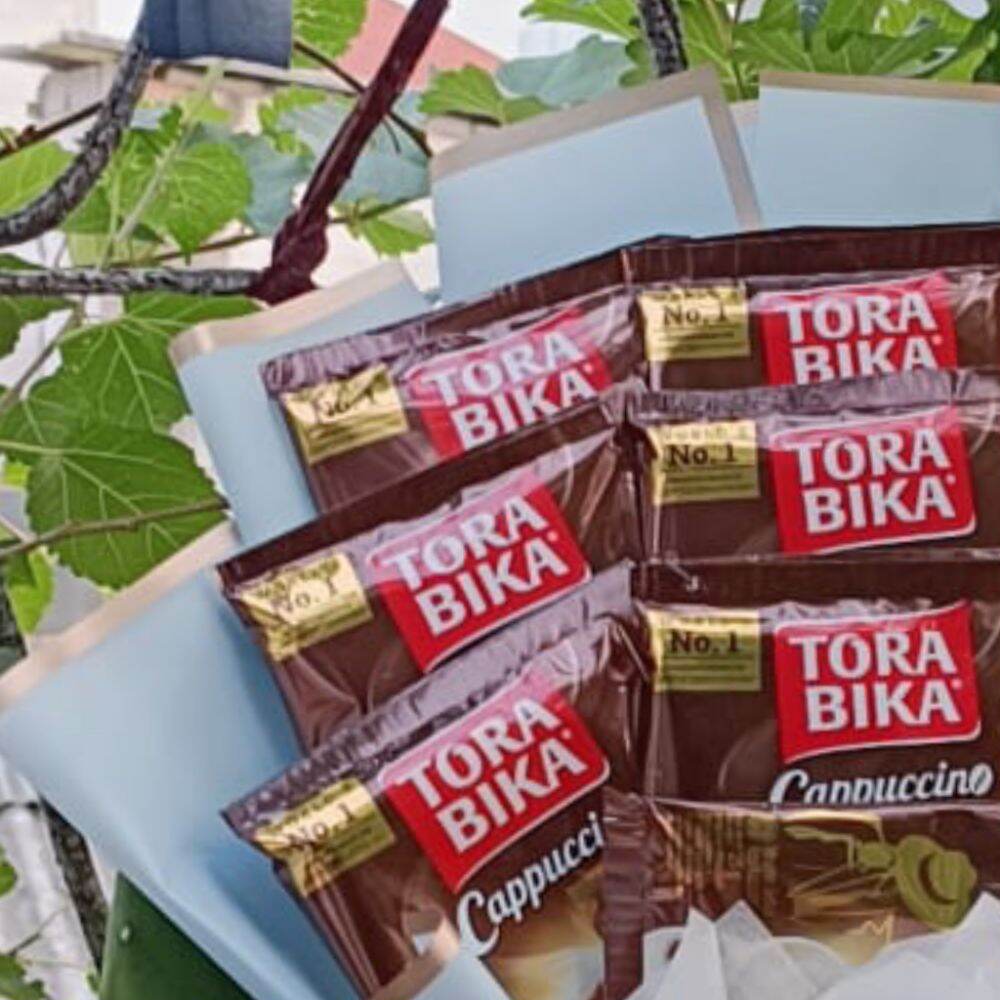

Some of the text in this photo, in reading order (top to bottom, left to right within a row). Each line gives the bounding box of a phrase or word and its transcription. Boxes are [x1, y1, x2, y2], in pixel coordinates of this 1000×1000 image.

[785, 290, 937, 344] TORA
[425, 330, 585, 408] TORA
[791, 335, 938, 385] BIKA
[448, 368, 590, 451] BIKA
[667, 442, 738, 467] No. 1
[786, 426, 949, 486] TORA
[801, 473, 957, 535] BIKA
[382, 493, 550, 590] TORA
[414, 537, 570, 638] BIKA
[668, 629, 741, 653] No. 1
[788, 630, 958, 681] TORA
[803, 678, 962, 733] BIKA
[400, 697, 561, 807] TORA
[769, 760, 994, 804] Cappuccino
[435, 738, 588, 854] BIKA
